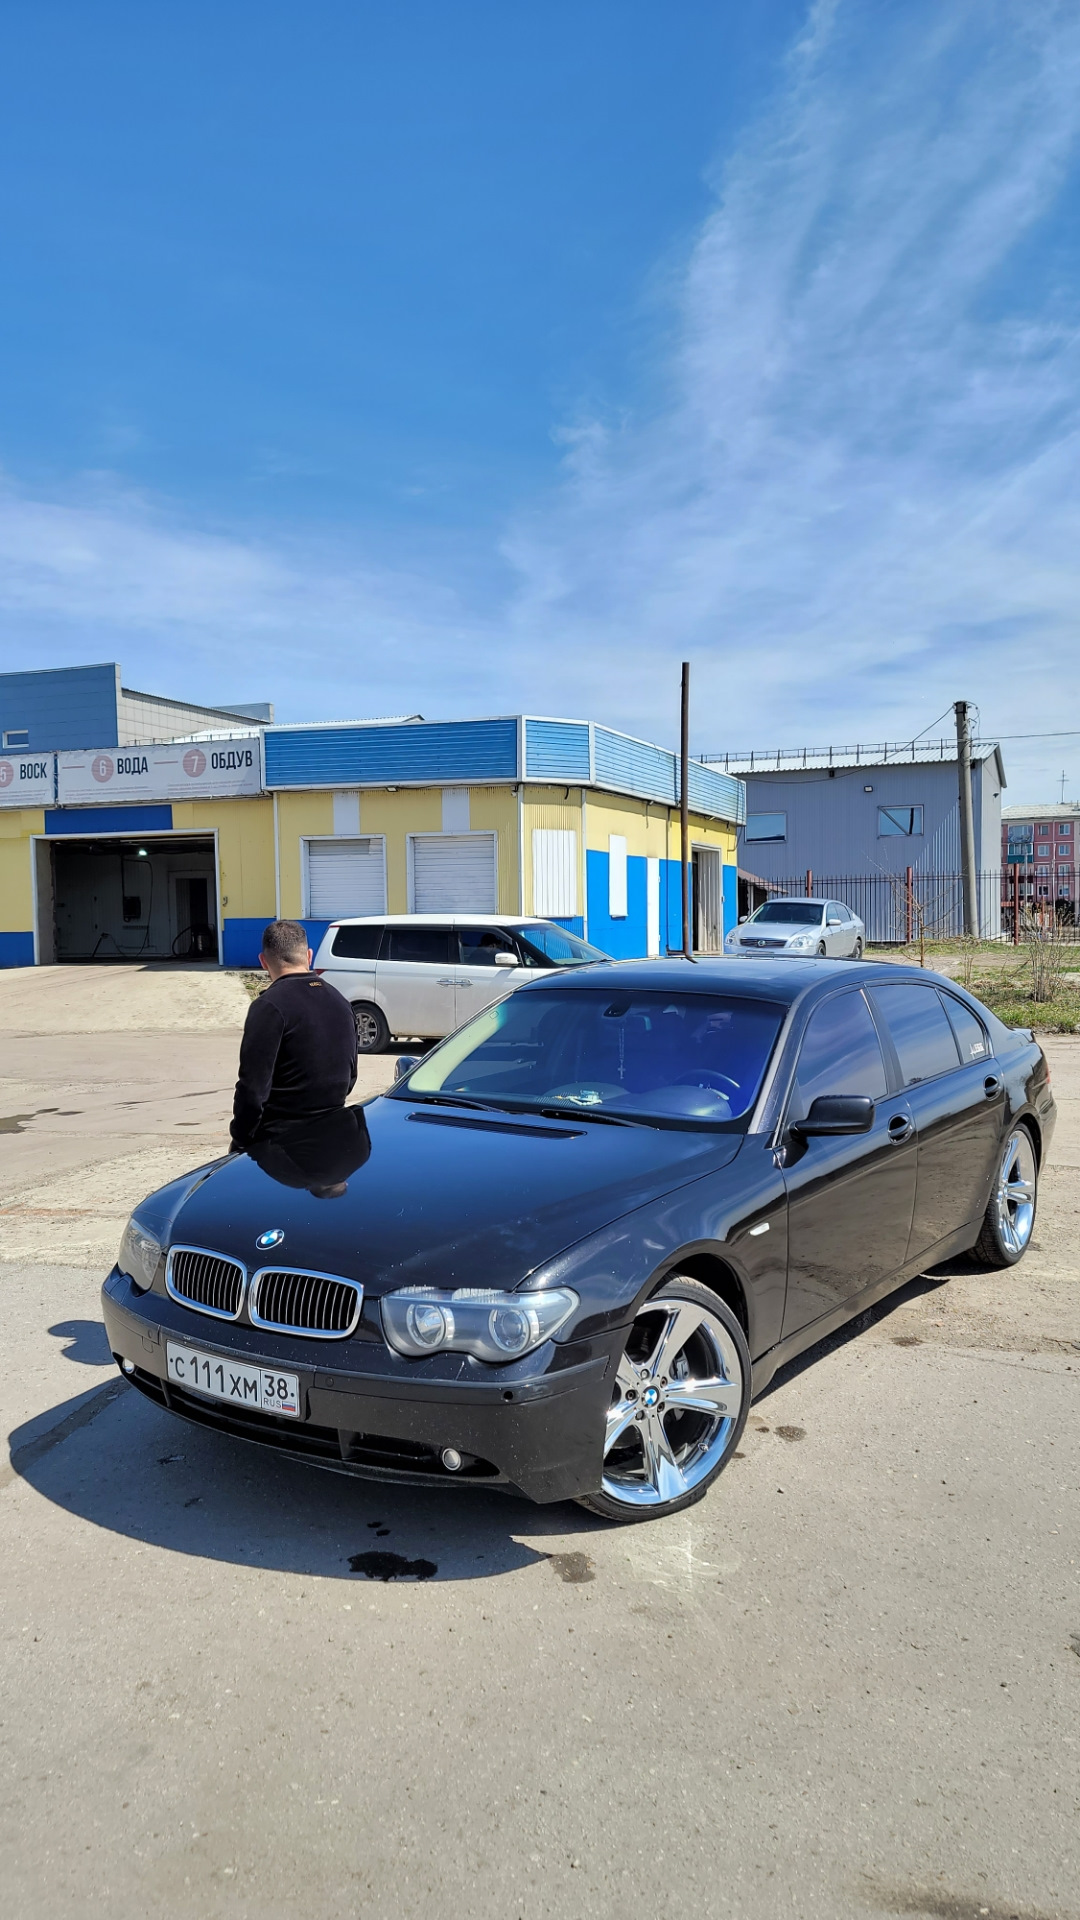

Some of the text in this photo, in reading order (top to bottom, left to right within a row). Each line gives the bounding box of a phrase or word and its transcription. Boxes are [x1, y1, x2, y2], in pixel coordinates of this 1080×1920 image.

[100, 757, 148, 777] 6 ВОДА
[191, 750, 253, 773] 7 ОБДУВ
[0, 762, 47, 782] 5 ВОСК
[264, 1374, 288, 1400] 38
[263, 1397, 281, 1408] RUS
